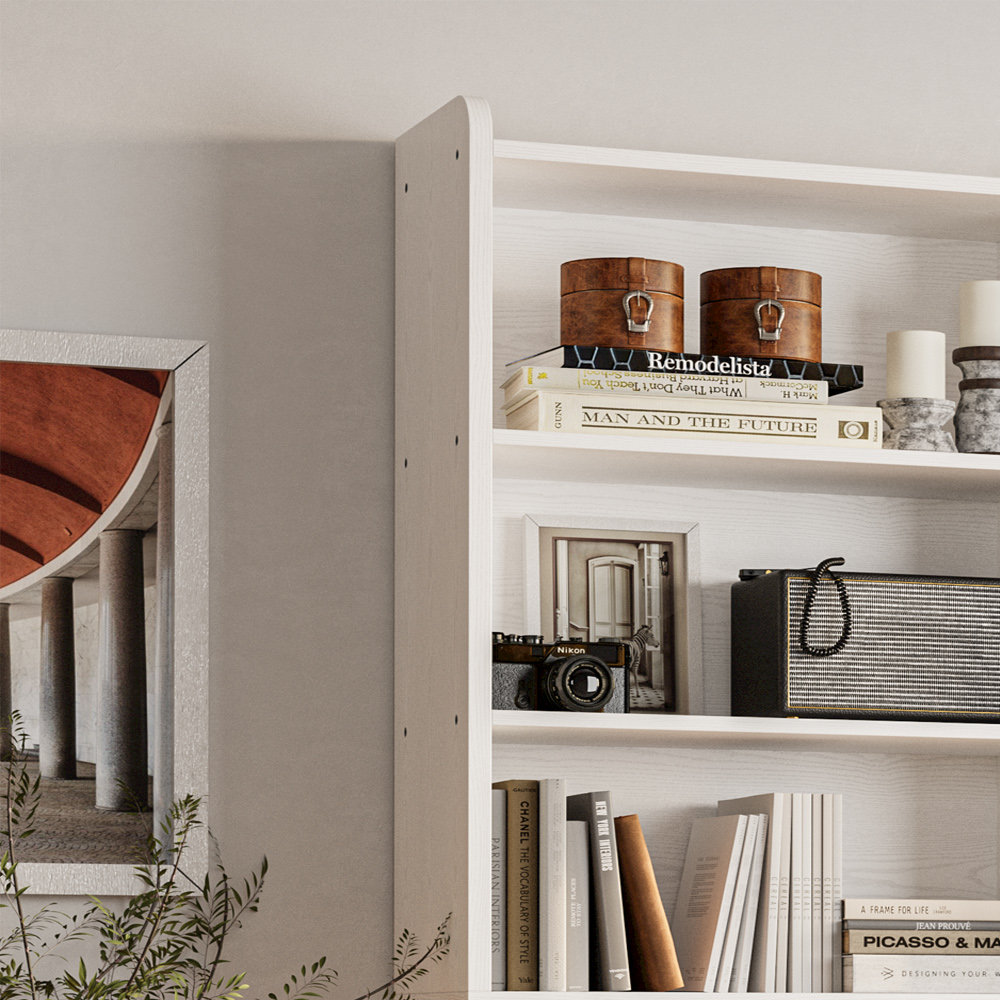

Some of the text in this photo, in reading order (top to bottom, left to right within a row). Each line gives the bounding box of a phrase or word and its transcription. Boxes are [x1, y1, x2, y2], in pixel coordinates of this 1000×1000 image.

[648, 351, 772, 377] Remodelista
[582, 378, 743, 398] What They Don't Teach You
[760, 381, 818, 391] McCormack
[793, 391, 818, 399] Mark
[582, 411, 817, 433] MAN AND THE FUTURE
[595, 801, 613, 872] NEW YORK INTERIORS
[520, 801, 530, 964] CHANEL THE VOCABULARY OF STYLE
[491, 838, 500, 953] PARISIAN INTERIORS
[861, 905, 929, 915] A FRAME FOR LIFE
[915, 921, 972, 931] JEAN PROUVÉ
[863, 936, 950, 948] PICASSO
[956, 937, 969, 949] &
[902, 970, 956, 978] DESIGNING
[962, 970, 988, 978] YOUR
